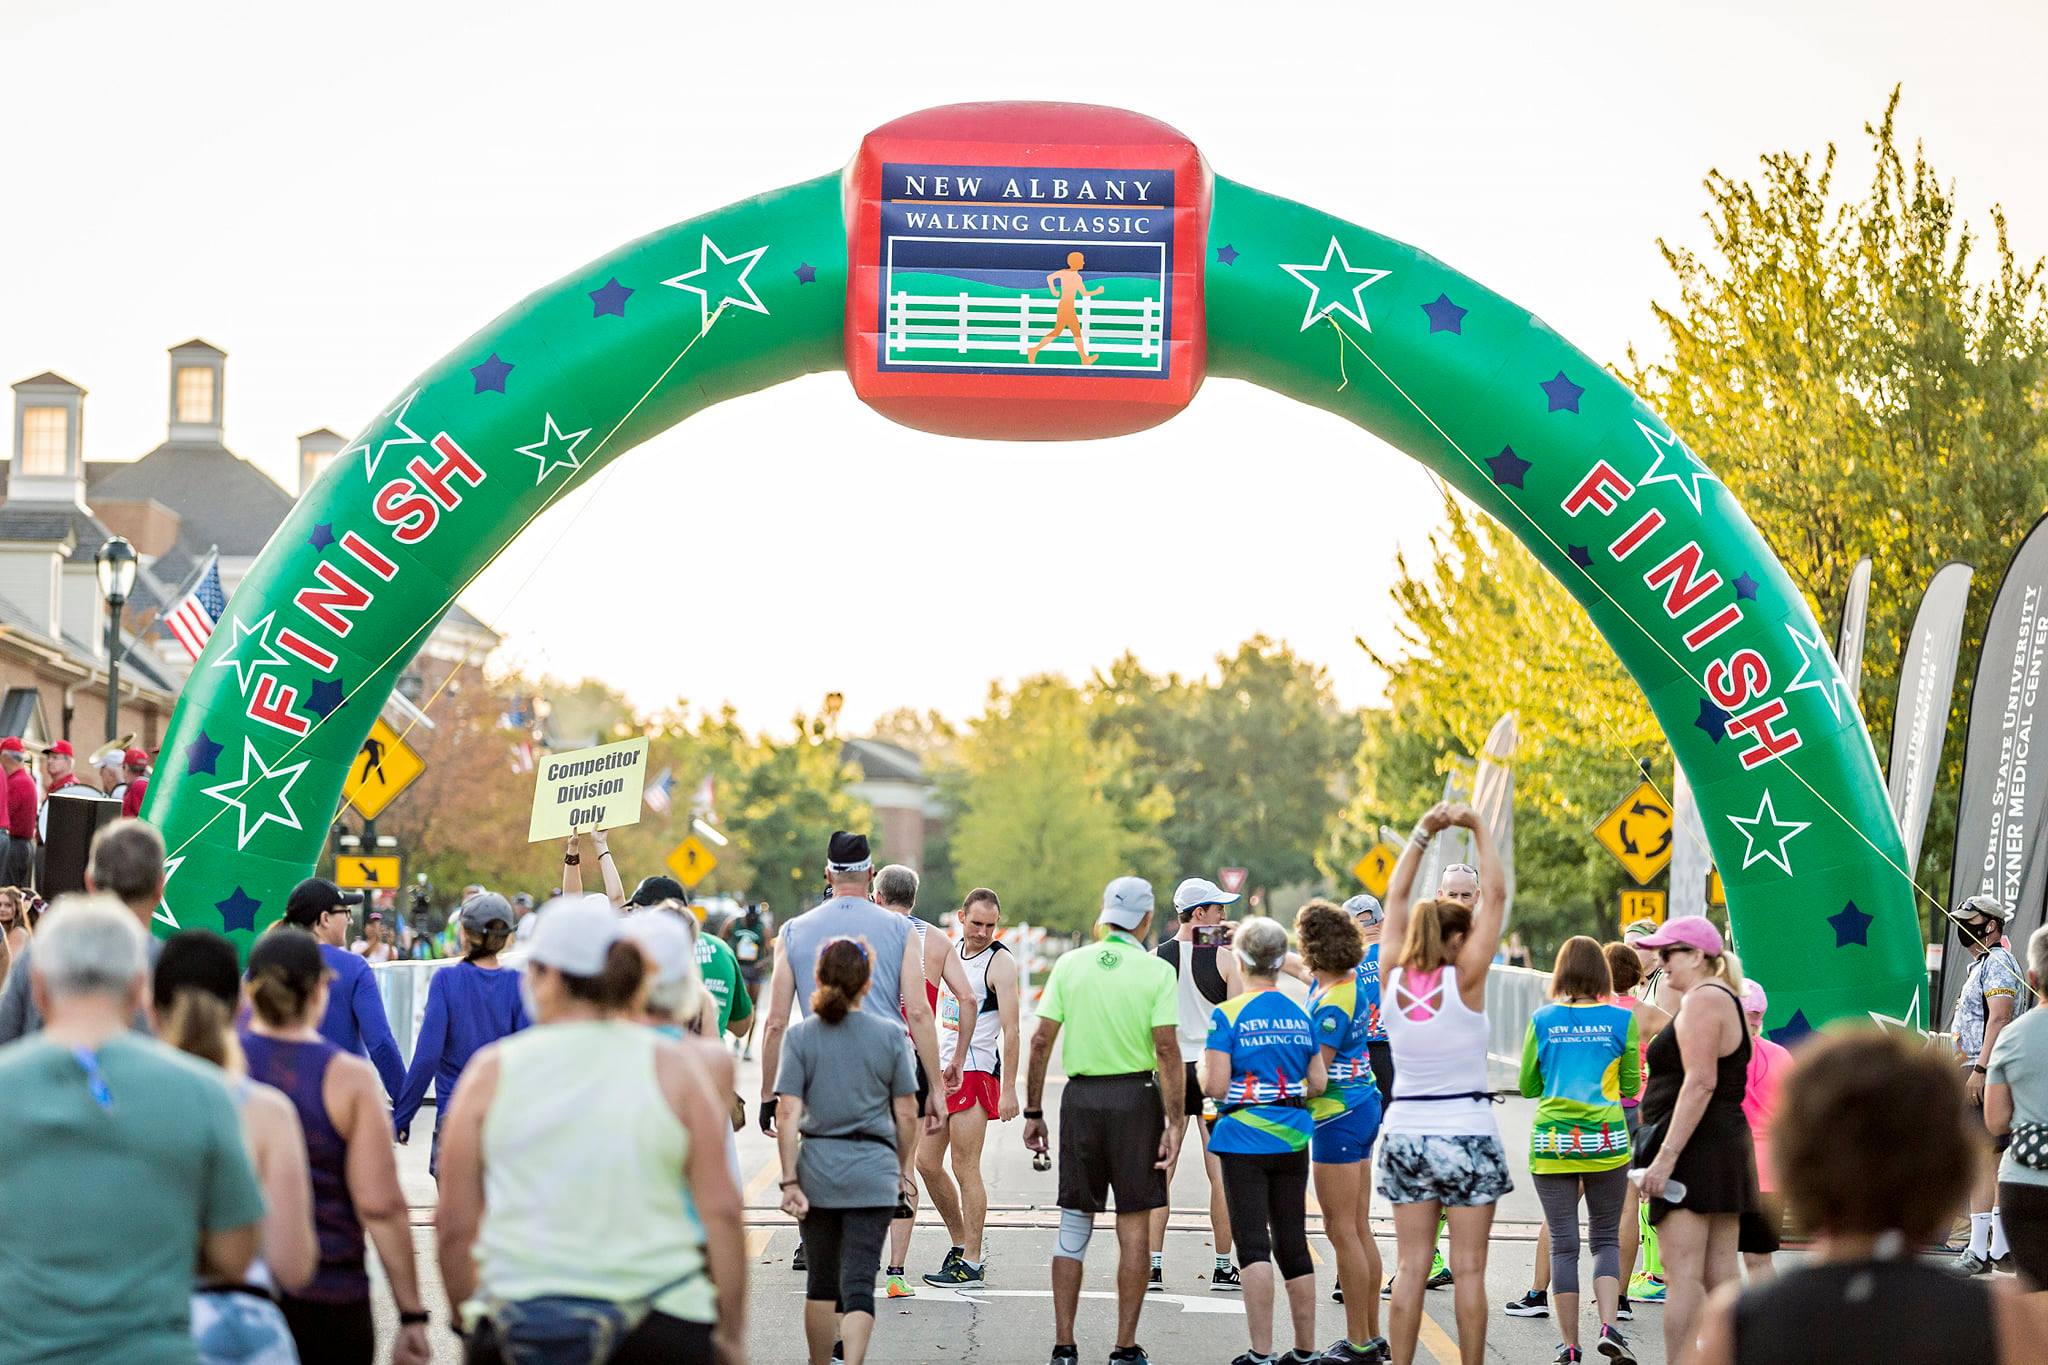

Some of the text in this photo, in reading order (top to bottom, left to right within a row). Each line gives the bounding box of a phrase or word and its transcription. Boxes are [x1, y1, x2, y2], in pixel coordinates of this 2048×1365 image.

[905, 175, 1152, 202] NEW ALBANY
[906, 212, 1151, 235] WALKING CLASSIC
[246, 431, 487, 738] FINISH
[1560, 459, 1803, 770] FINISH
[1908, 628, 1933, 760] UNIVERSITY
[1917, 663, 1937, 744] CENTER
[1984, 812, 2001, 872] OHIO
[1993, 736, 2012, 806] STATE
[2003, 585, 2036, 730] UNIVERSITY
[547, 749, 641, 782] Competitor
[2004, 616, 2048, 923] WEXNER MEDICAL CENTER
[557, 778, 624, 804] Division
[569, 805, 606, 826] Only
[1631, 897, 1656, 917] 15
[1239, 1019, 1269, 1033] NEW
[1547, 1024, 1613, 1034] NEW ALBANY
[1240, 1035, 1292, 1048] WALKING
